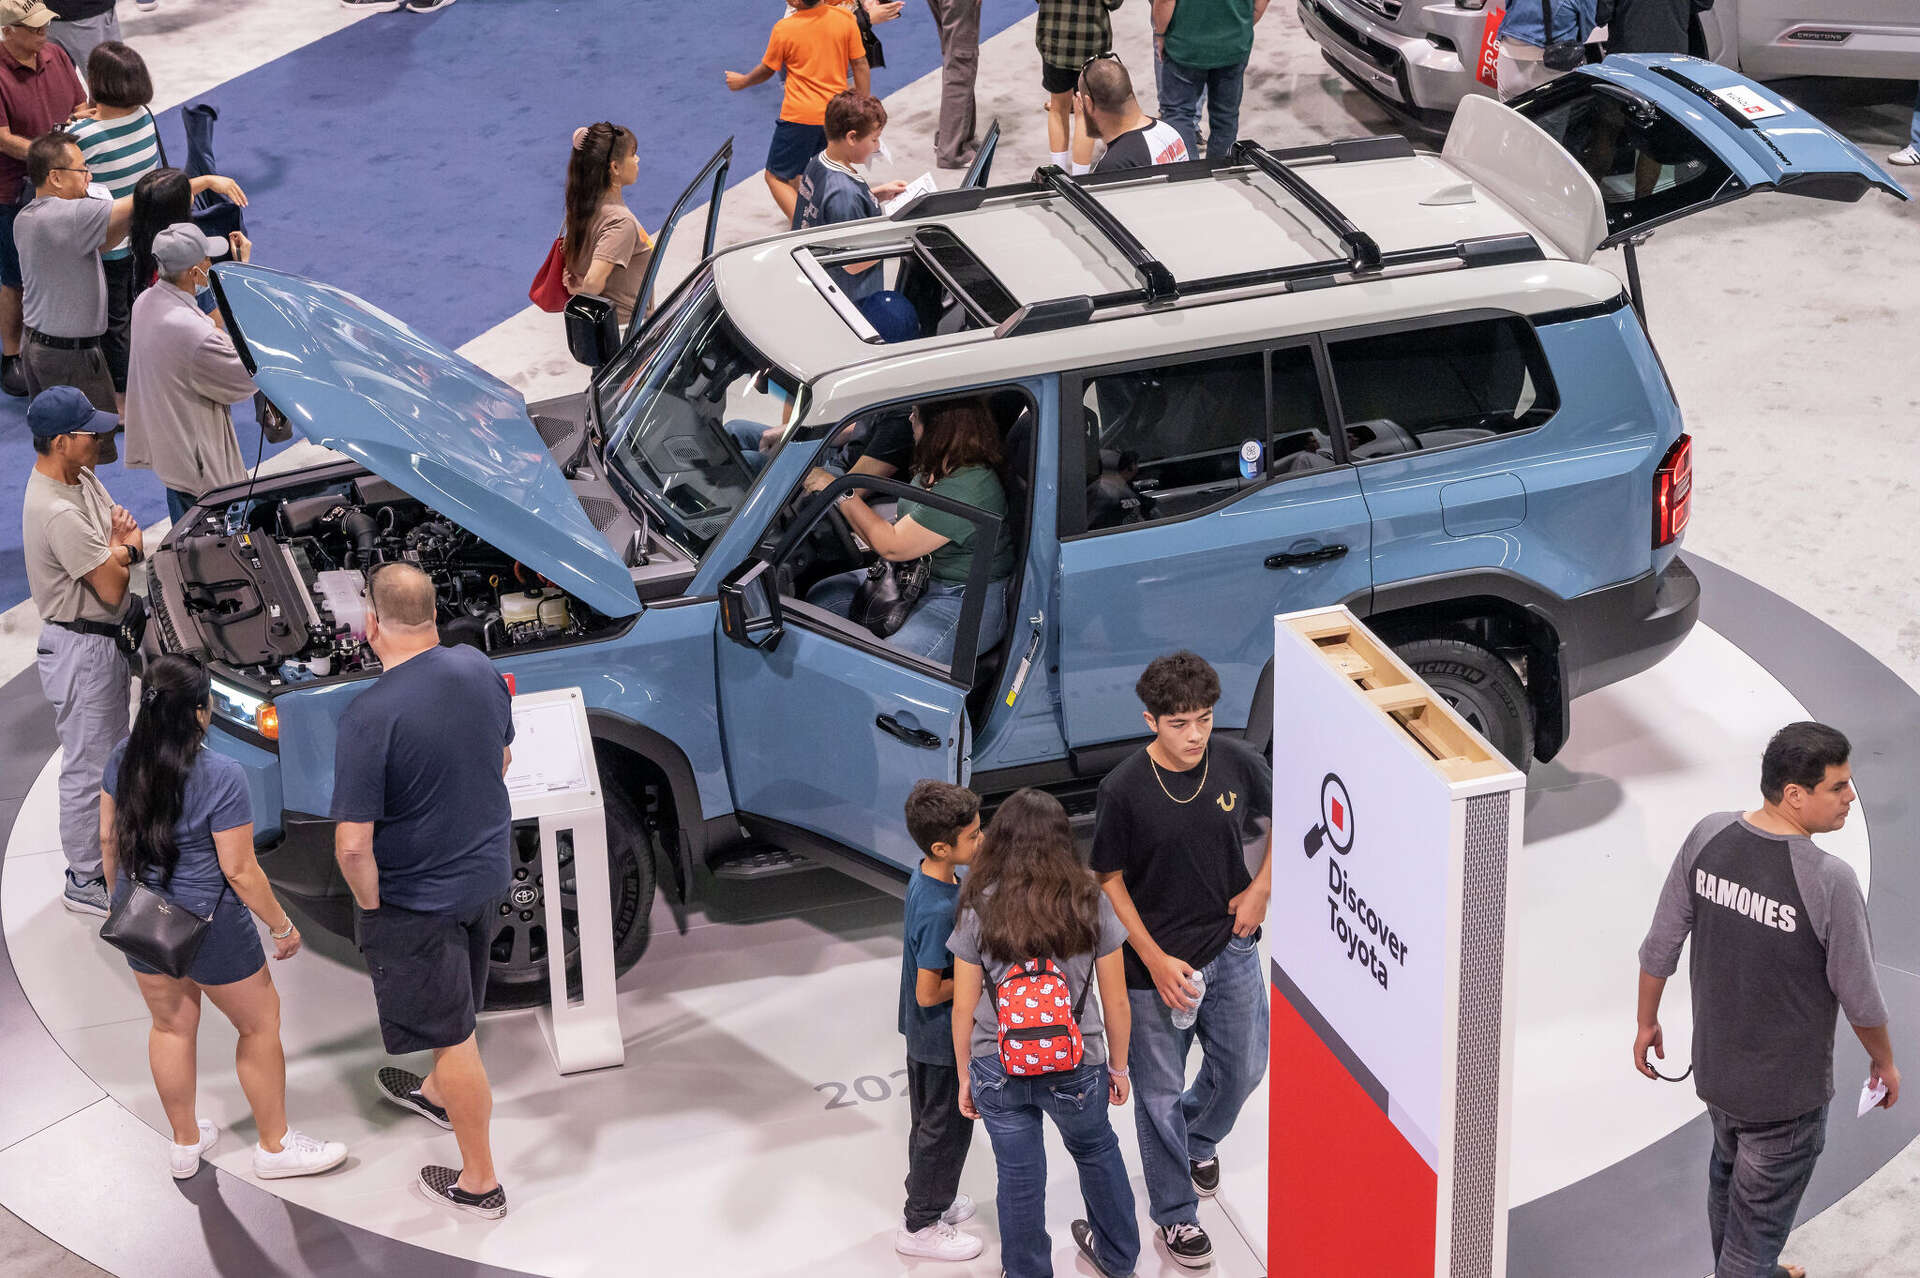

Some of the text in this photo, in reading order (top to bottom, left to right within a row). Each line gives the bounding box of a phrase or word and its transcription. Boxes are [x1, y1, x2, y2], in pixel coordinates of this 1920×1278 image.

[1327, 895, 1388, 990] Toyota
[1328, 856, 1408, 967] Discover
[1695, 868, 1796, 933] RAMONES
